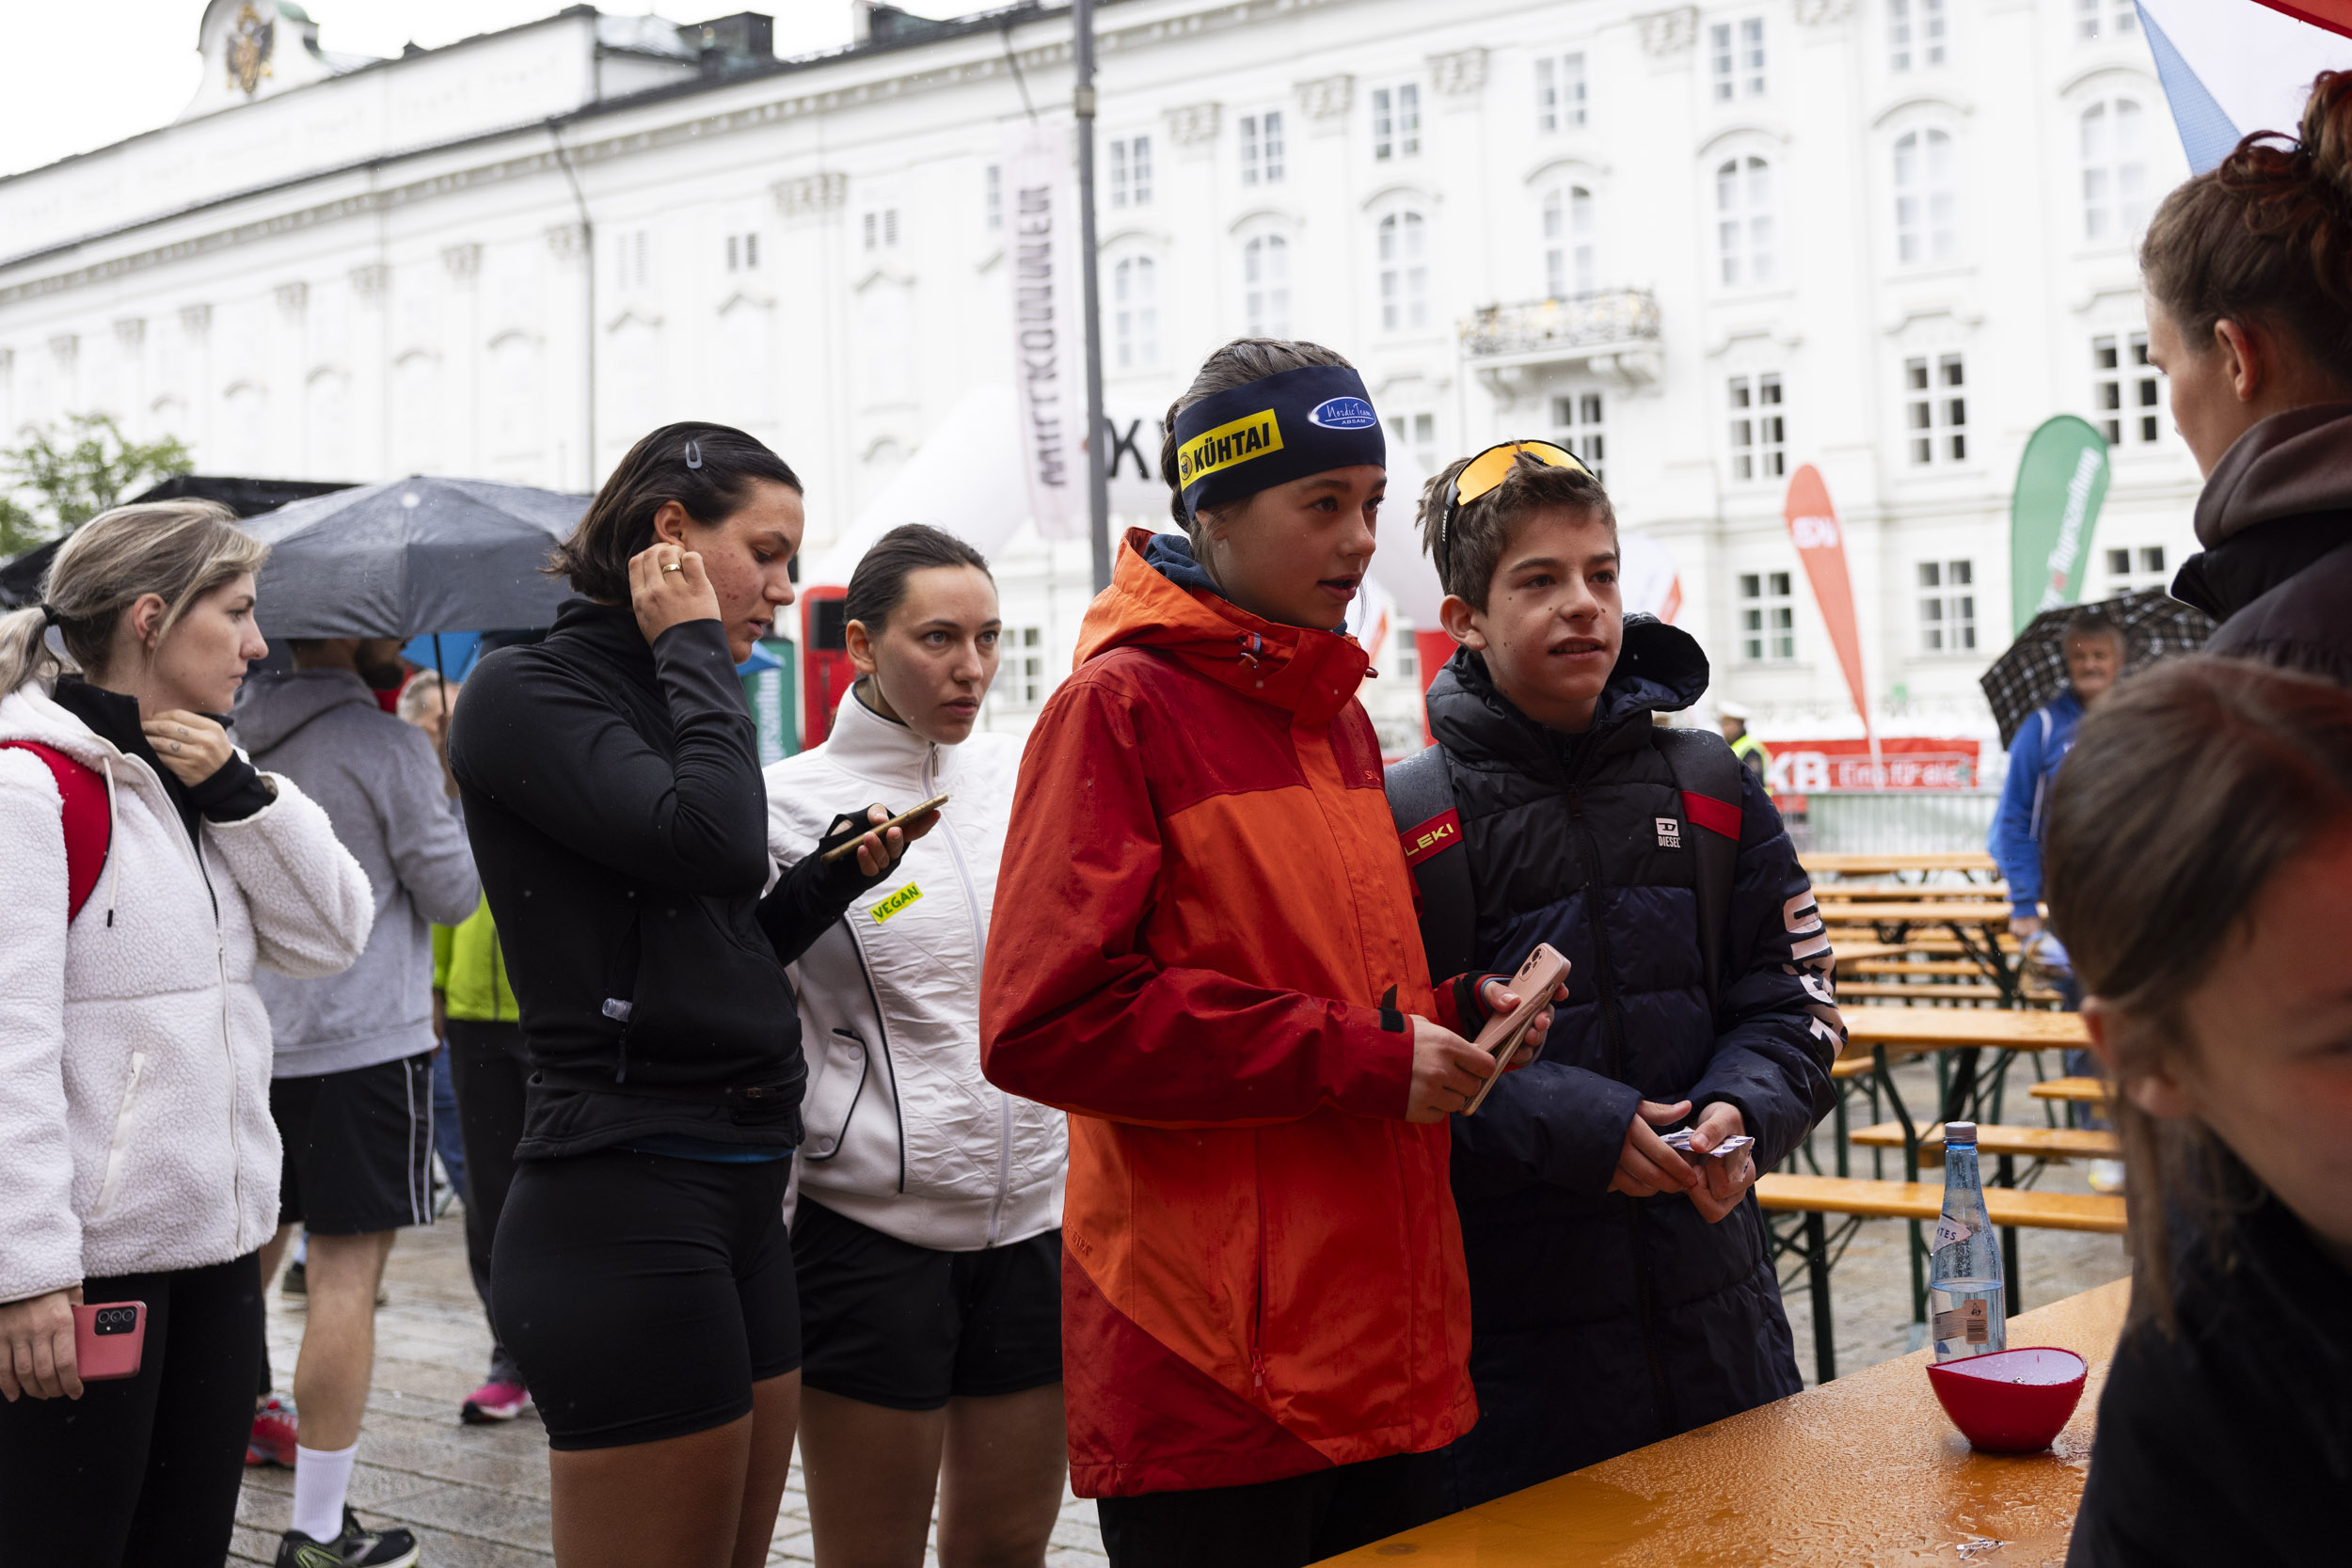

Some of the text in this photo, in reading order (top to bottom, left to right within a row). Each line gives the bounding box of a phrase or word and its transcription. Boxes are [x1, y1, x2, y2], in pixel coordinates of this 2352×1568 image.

[1327, 403, 1372, 419] Nordic Team
[1194, 421, 1270, 473] KÜHTAI
[1405, 823, 1454, 857] LEKI
[1658, 836, 1681, 848] DIESEL
[873, 885, 919, 918] VEGAN
